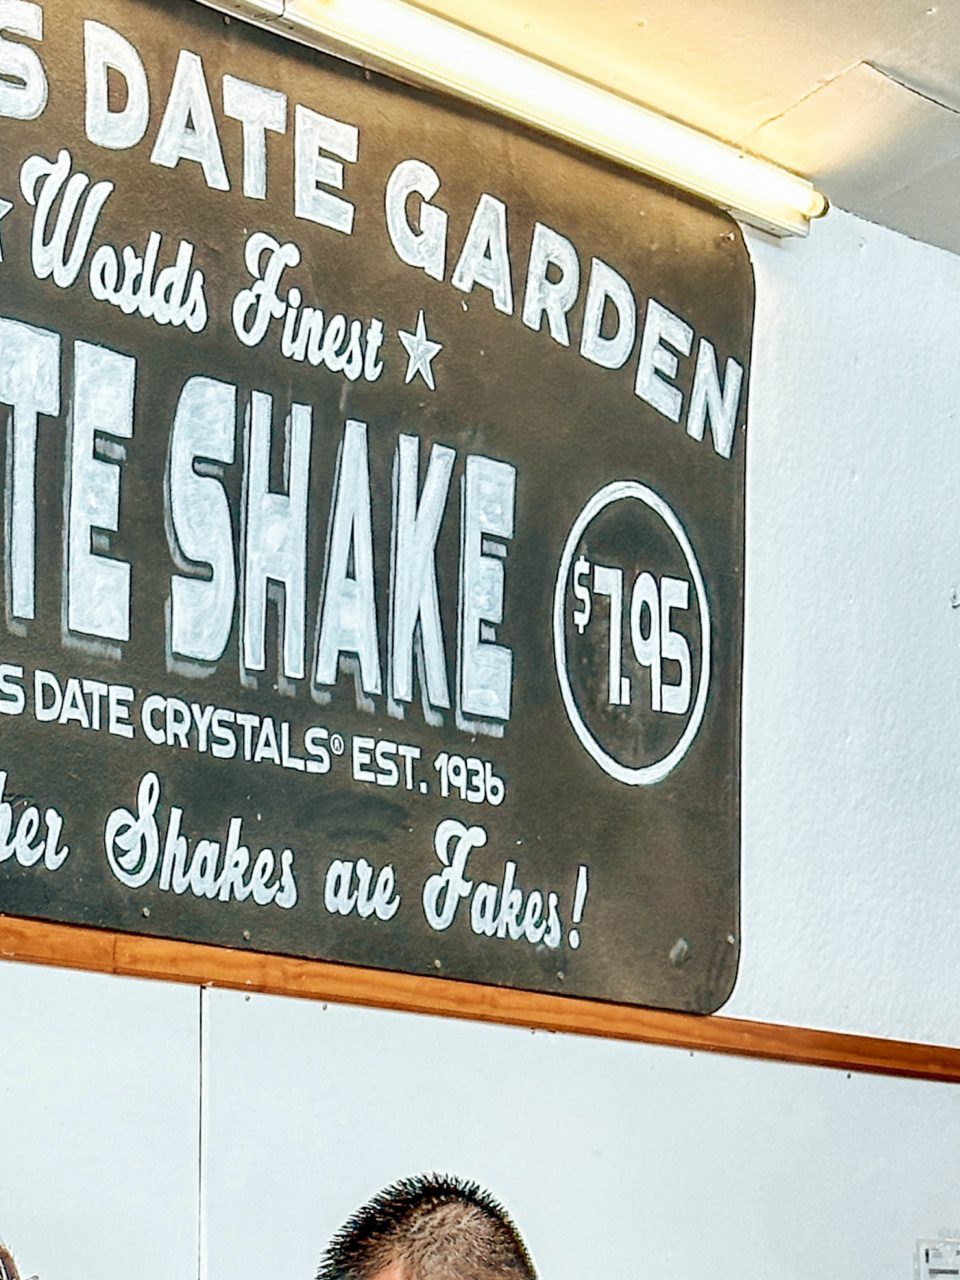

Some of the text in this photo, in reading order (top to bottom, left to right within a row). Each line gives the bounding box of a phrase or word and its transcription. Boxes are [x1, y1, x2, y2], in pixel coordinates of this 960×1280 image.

[19, 149, 384, 382] Worlds Finest
[82, 18, 360, 234] DATE
[384, 158, 744, 460] GARDEN
[162, 374, 518, 736] SHAKE
[573, 554, 692, 715] $7.95
[33, 668, 135, 740] DATE
[351, 736, 428, 796] EST.
[433, 750, 506, 807] 1936
[103, 770, 299, 912] Shakes
[323, 856, 401, 922] are
[422, 817, 590, 951] Fakes!
